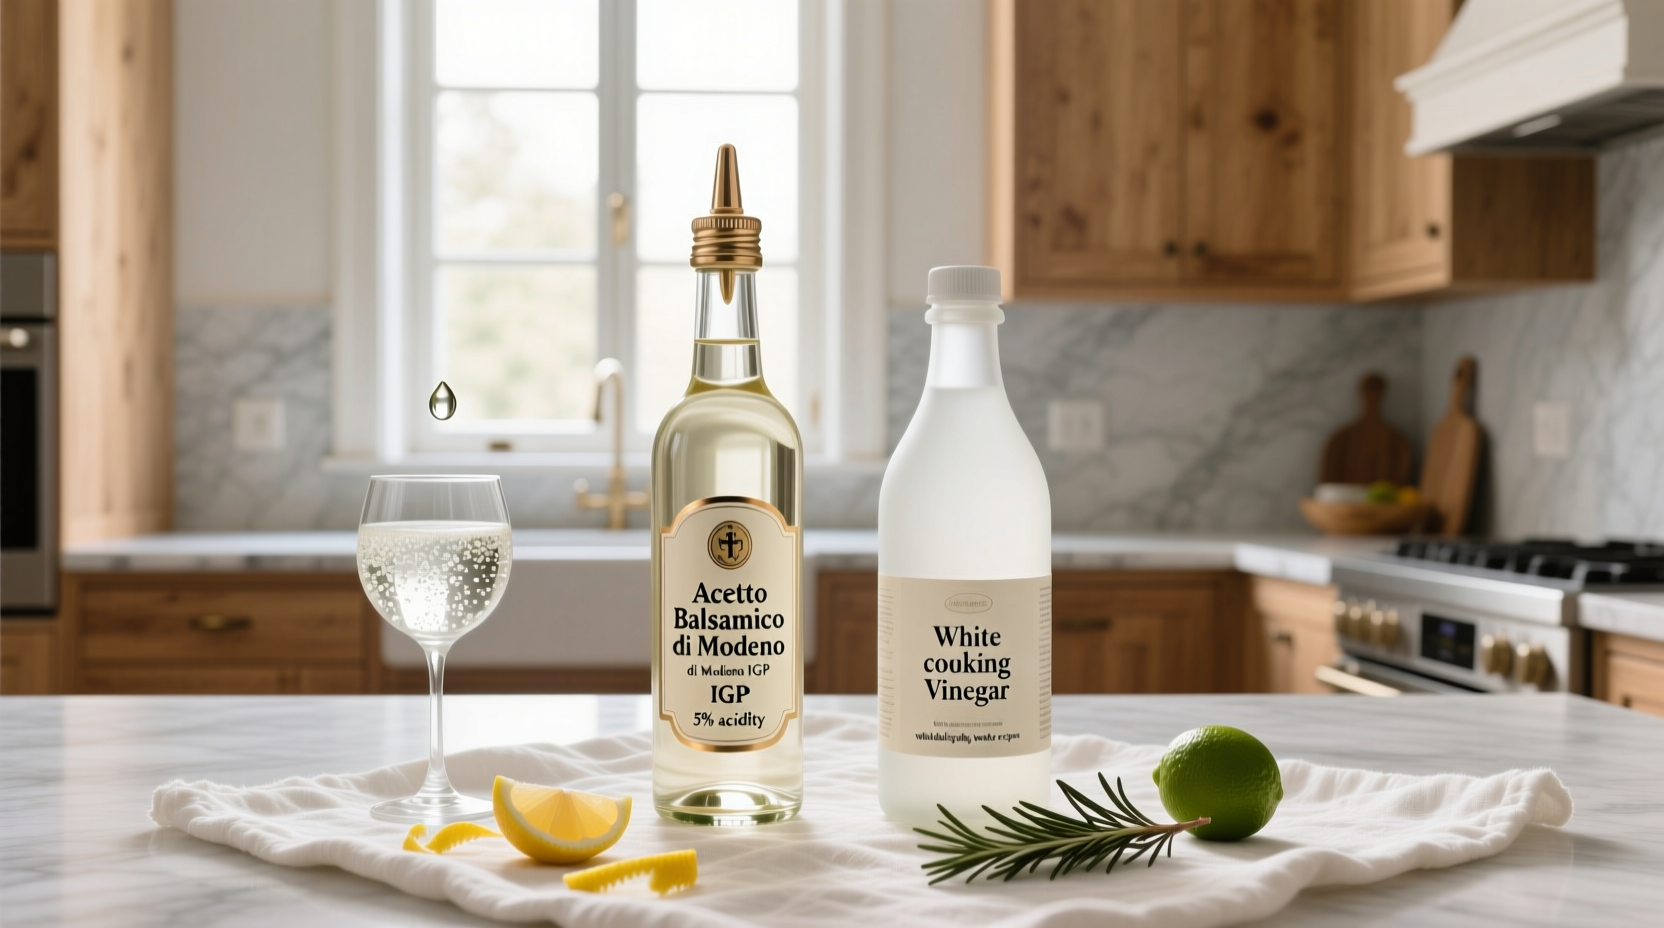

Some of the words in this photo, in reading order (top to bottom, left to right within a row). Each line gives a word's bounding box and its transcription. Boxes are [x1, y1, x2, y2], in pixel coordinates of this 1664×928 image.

[692, 582, 767, 604] Acetto
[674, 607, 784, 630] Balsamico
[673, 634, 691, 656] di
[697, 634, 785, 656] Modeno
[932, 625, 1001, 647] White
[686, 664, 697, 676] di
[748, 664, 771, 676] IGP
[711, 685, 750, 703] IGP
[924, 678, 1010, 707] Vinegar
[693, 711, 714, 727] 5%
[718, 711, 766, 729] acidity
